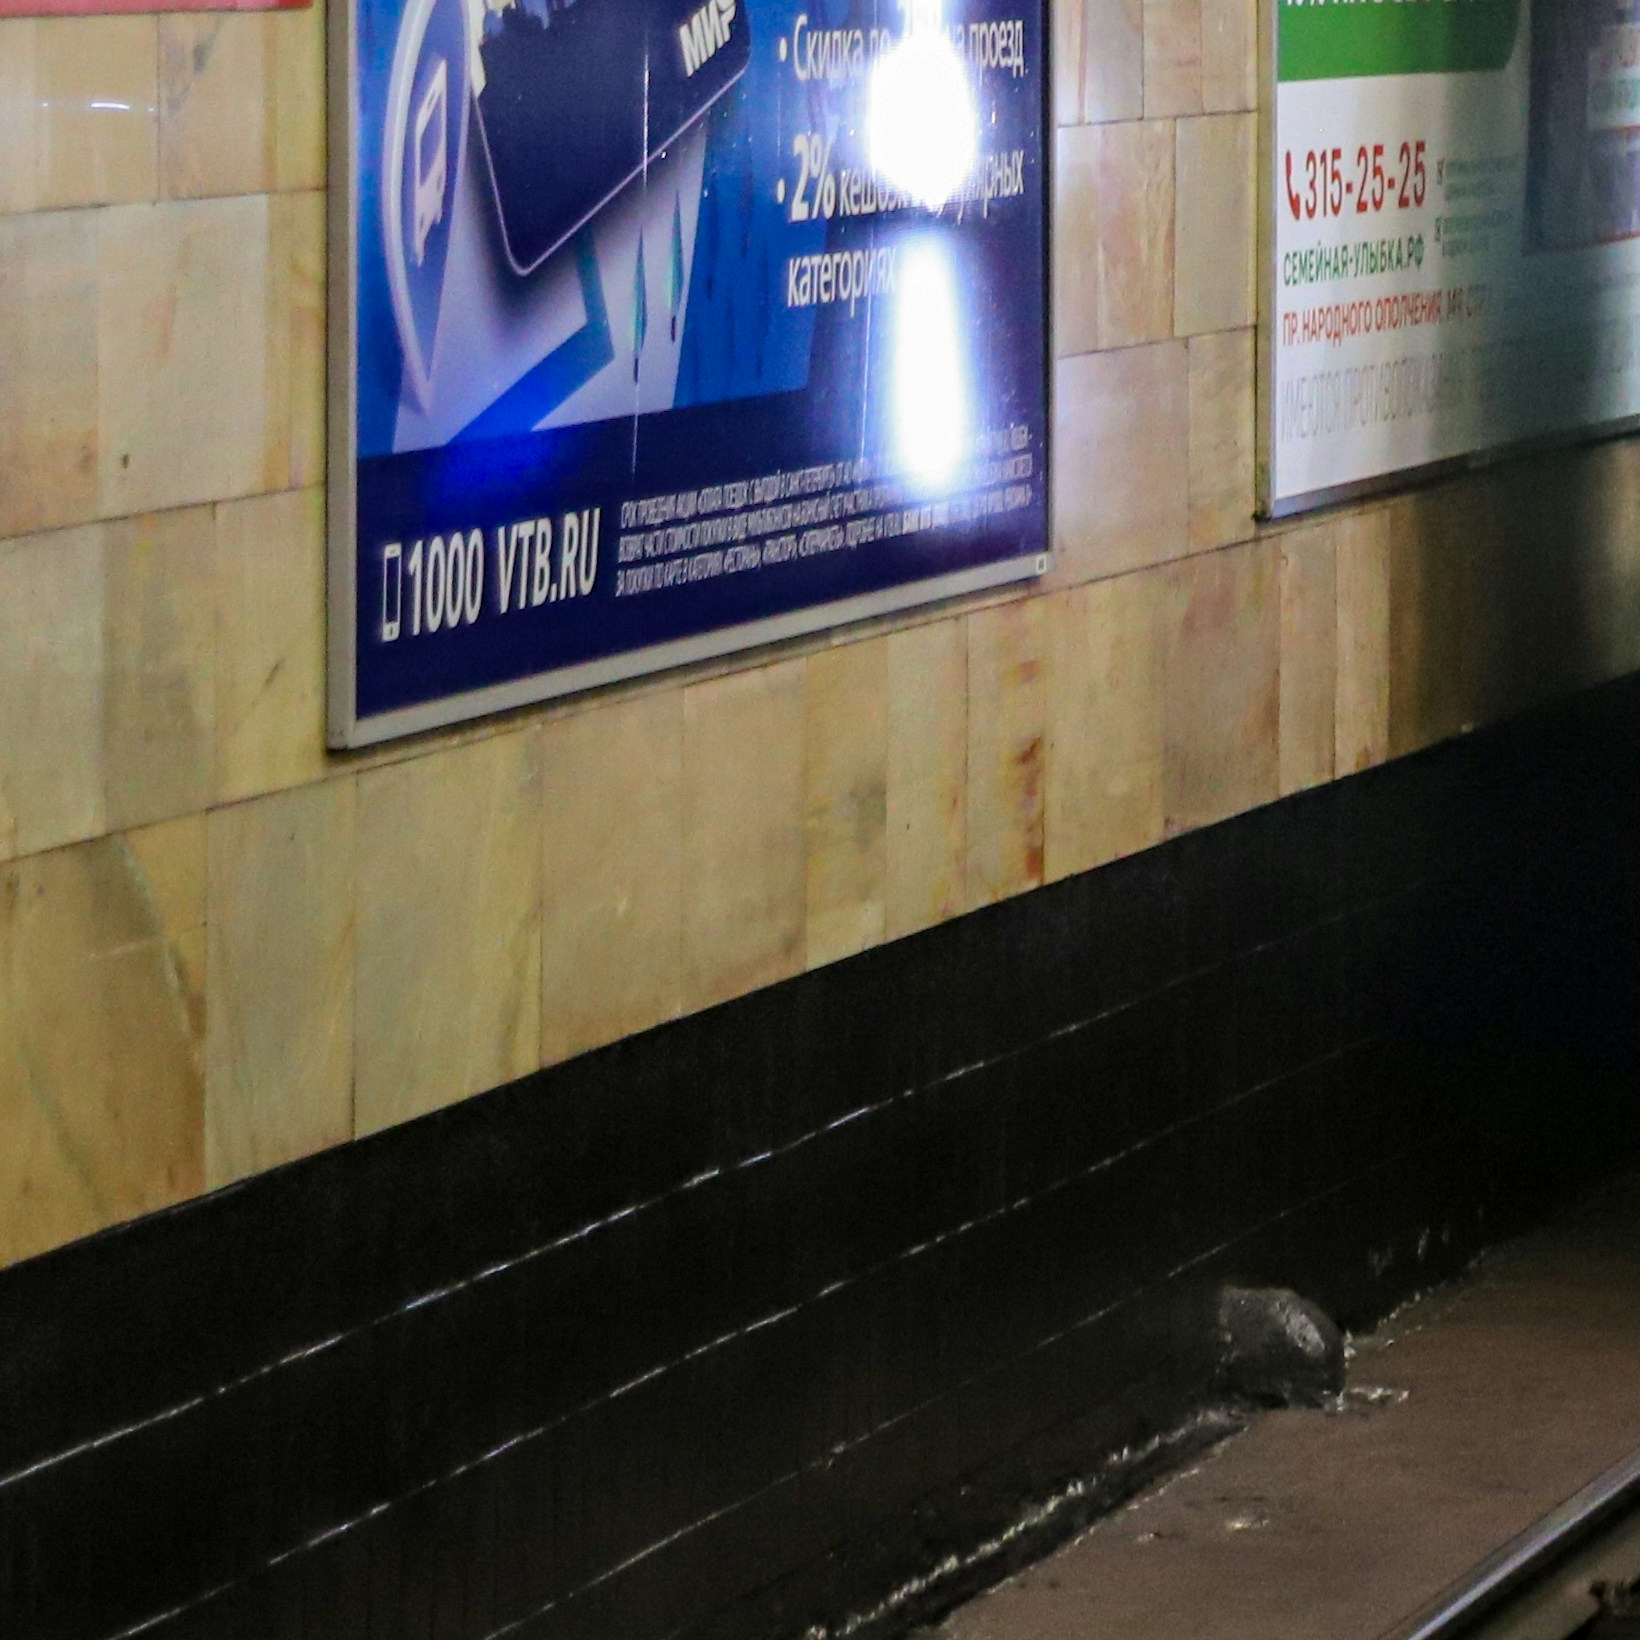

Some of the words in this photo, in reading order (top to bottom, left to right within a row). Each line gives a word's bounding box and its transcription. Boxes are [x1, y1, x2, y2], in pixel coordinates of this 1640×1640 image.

[792, 13, 865, 87] Скидка
[789, 133, 836, 223] 2%
[1305, 139, 1427, 220] 315-25-25
[787, 247, 897, 318] категориях
[1283, 233, 1425, 287] СЕМЕЙНАЯ-УЛЫБКА.РФ
[1302, 299, 1372, 348] НАРОДНОГО
[408, 527, 485, 637] 1000
[497, 506, 601, 615] VTB.RU
